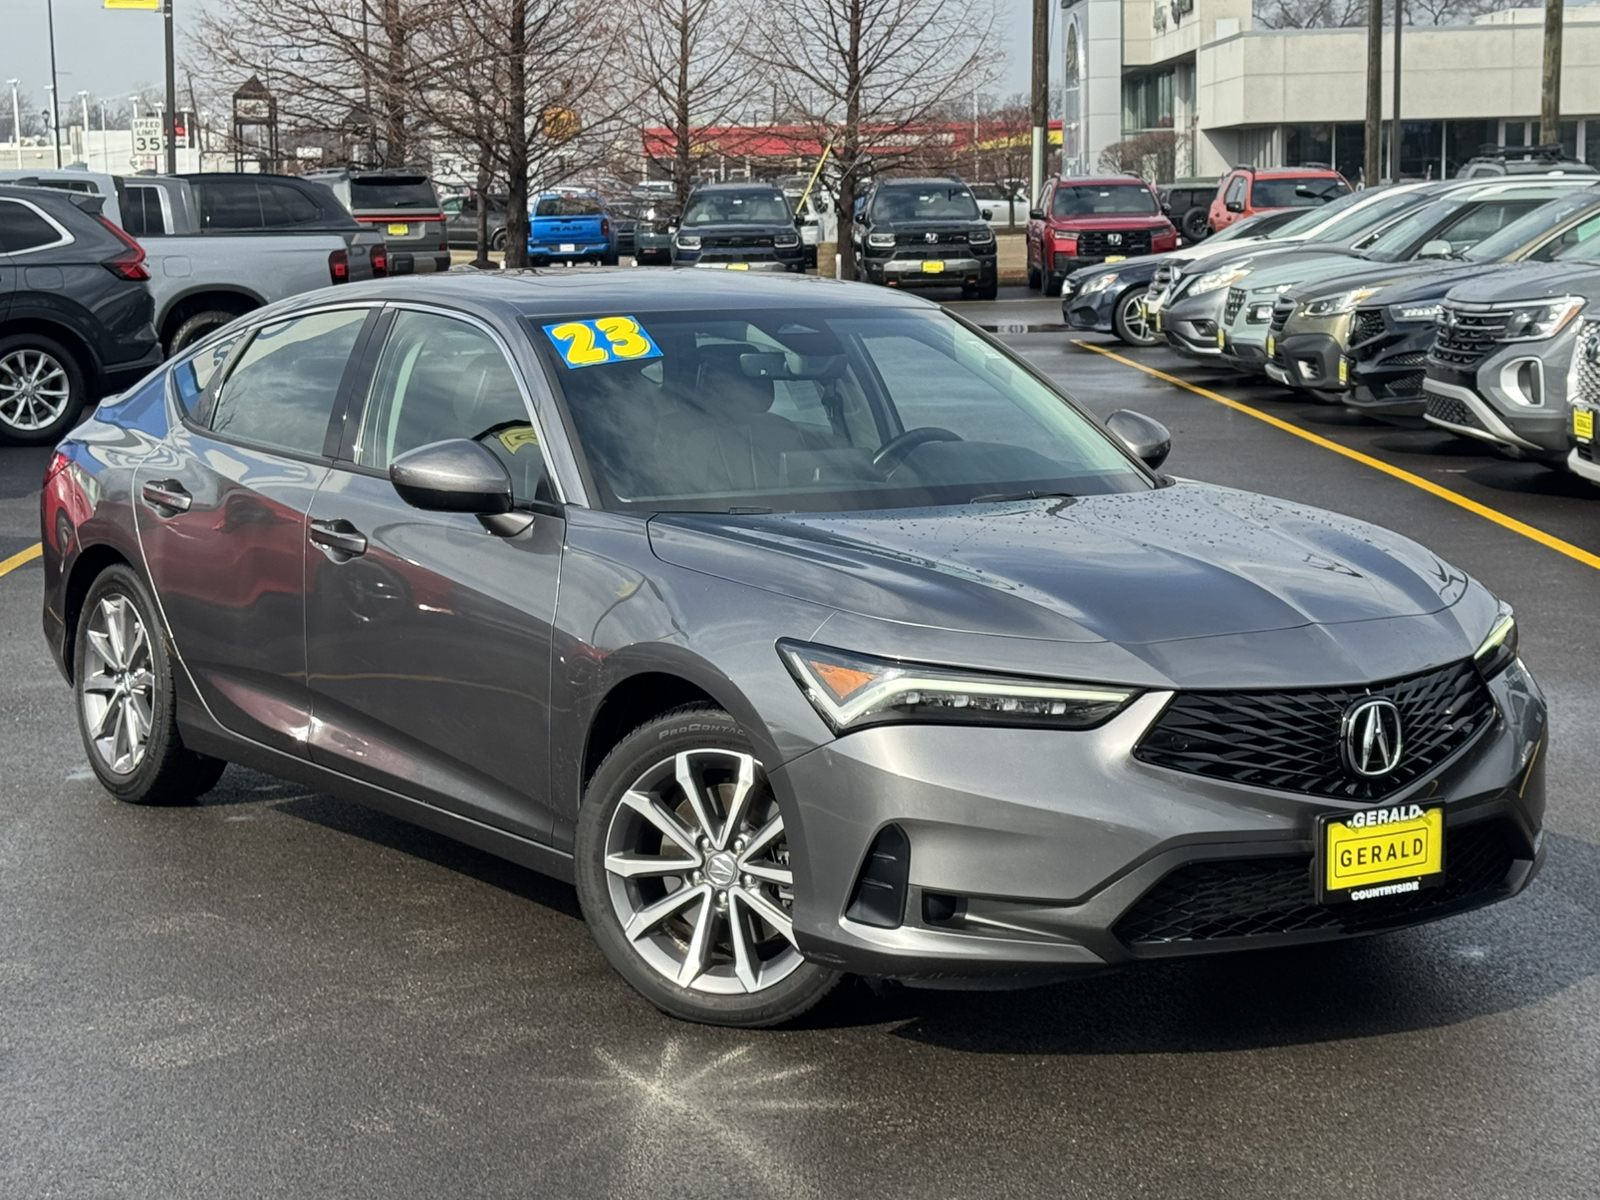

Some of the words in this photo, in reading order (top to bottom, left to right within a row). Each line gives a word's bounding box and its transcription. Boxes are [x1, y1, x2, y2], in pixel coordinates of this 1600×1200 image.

[136, 138, 161, 151] 35
[552, 316, 652, 365] 23
[1352, 804, 1421, 827] GERALD
[1340, 838, 1424, 868] GERALD
[1351, 881, 1420, 901] COUNTRYSIDE
